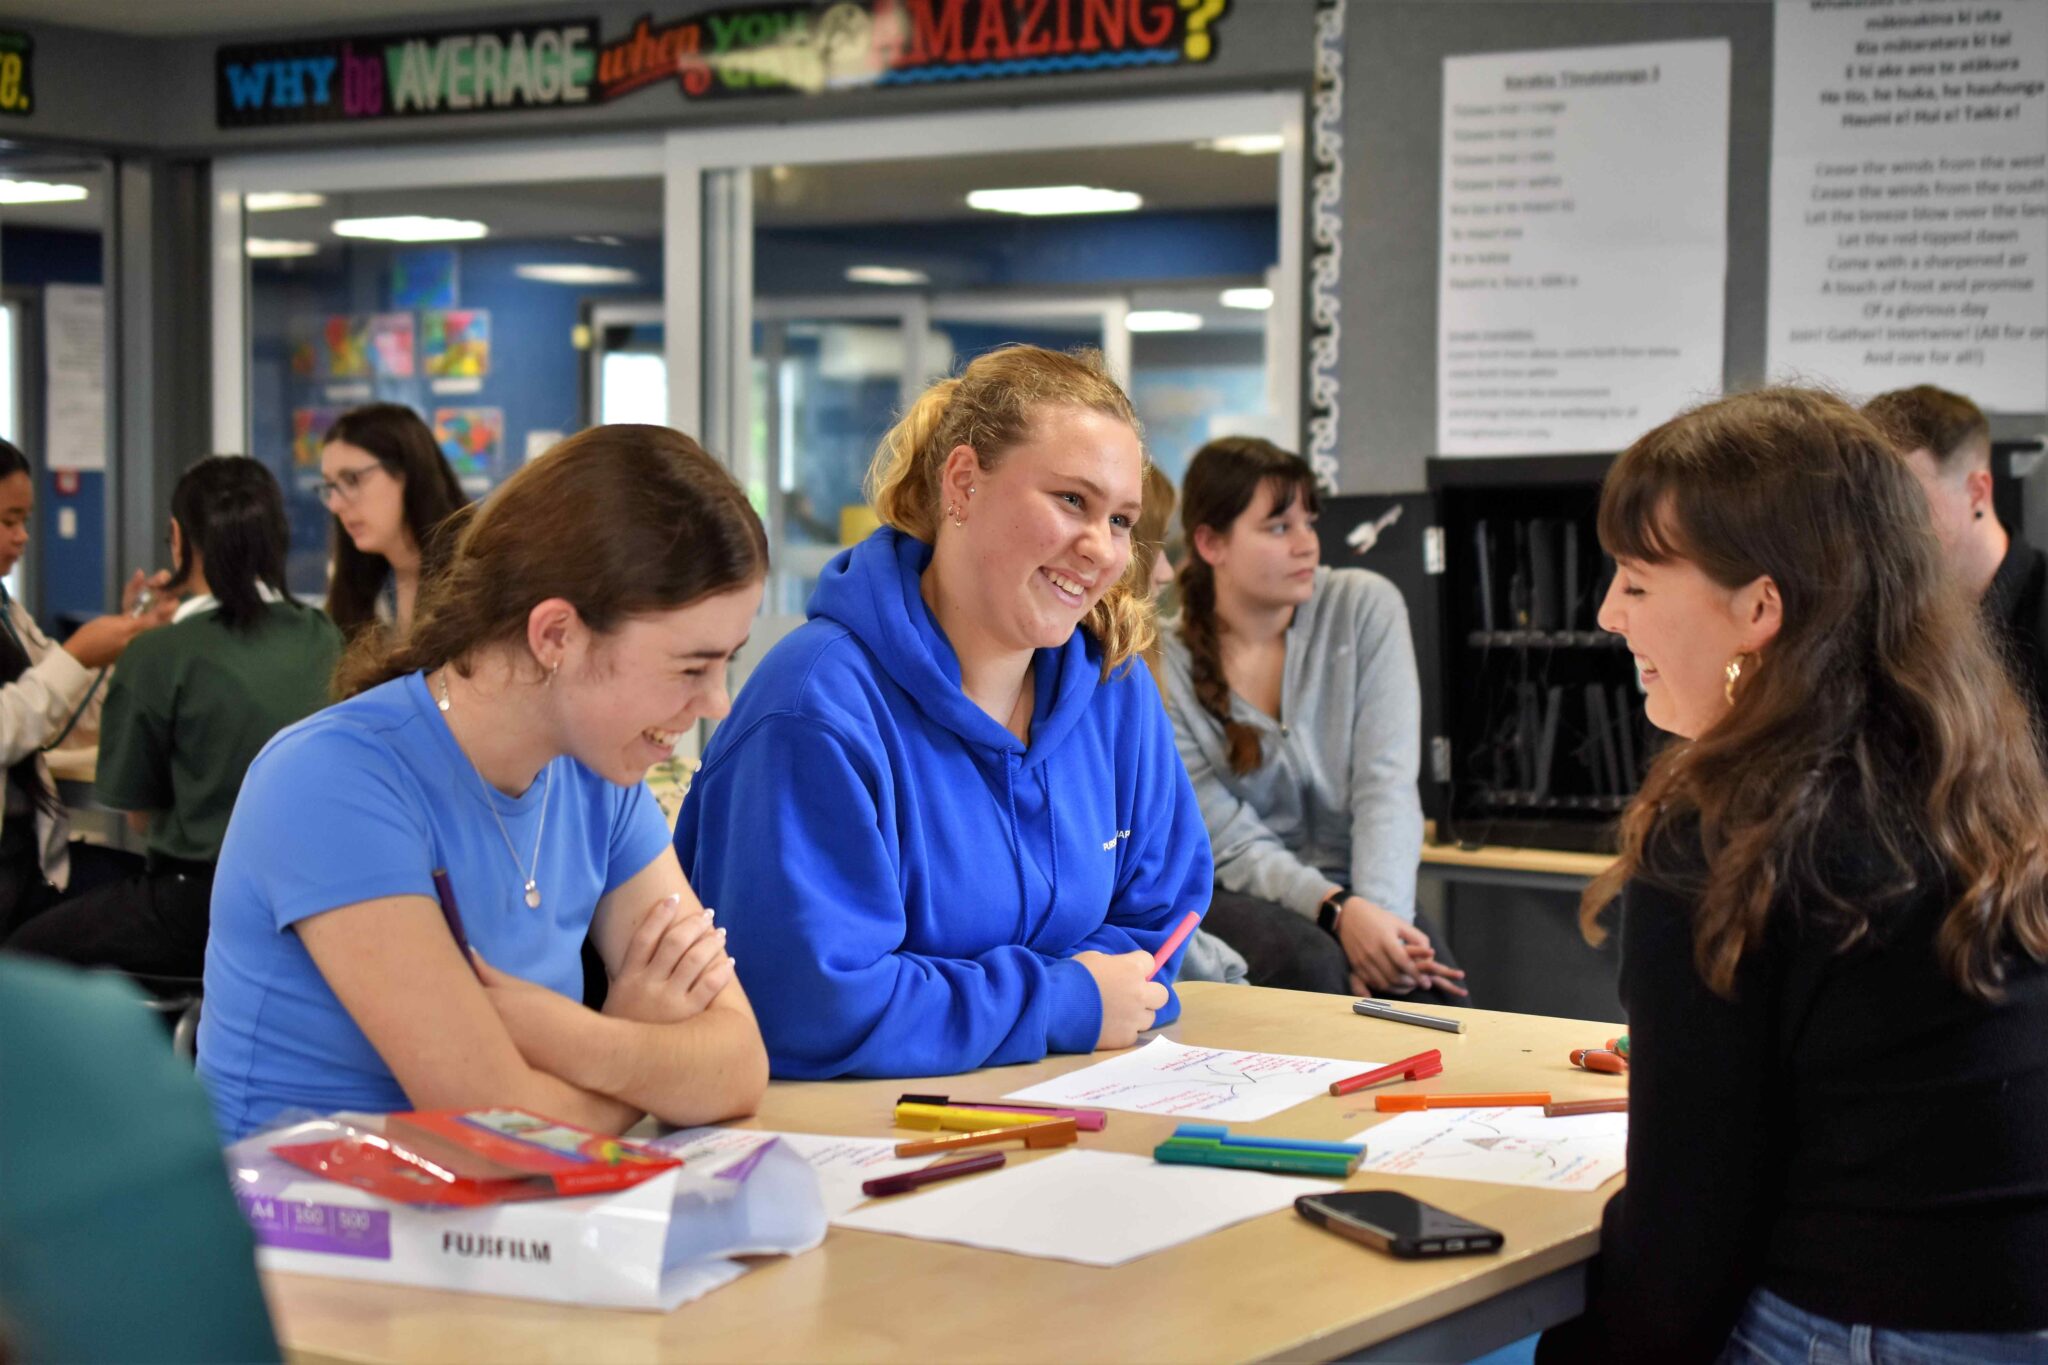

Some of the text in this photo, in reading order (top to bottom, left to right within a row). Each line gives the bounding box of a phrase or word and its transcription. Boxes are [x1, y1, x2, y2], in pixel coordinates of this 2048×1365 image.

[226, 56, 338, 109] WHY
[342, 42, 383, 116] be
[398, 27, 590, 109] AVERAGE
[600, 17, 700, 84] when
[1862, 159, 1887, 176] the
[1938, 155, 1976, 173] from
[1980, 154, 2005, 171] the
[1858, 182, 1883, 198] the
[1934, 179, 1972, 196] from
[1975, 178, 2001, 195] the
[1805, 208, 1827, 226] Let
[1831, 206, 1855, 223] the
[1953, 206, 1988, 220] over
[1992, 203, 2019, 218] the
[1837, 231, 1860, 248] Let
[1864, 230, 1889, 247] the
[1975, 227, 2019, 245] dawn
[1827, 254, 1871, 272] Come
[1874, 253, 1907, 270] with
[1881, 278, 1897, 294] of
[1938, 276, 1968, 293] and
[1960, 300, 1989, 320] day
[2003, 323, 2026, 340] for
[1863, 350, 1894, 367] And
[1896, 353, 1926, 366] one
[1929, 349, 1951, 366] for
